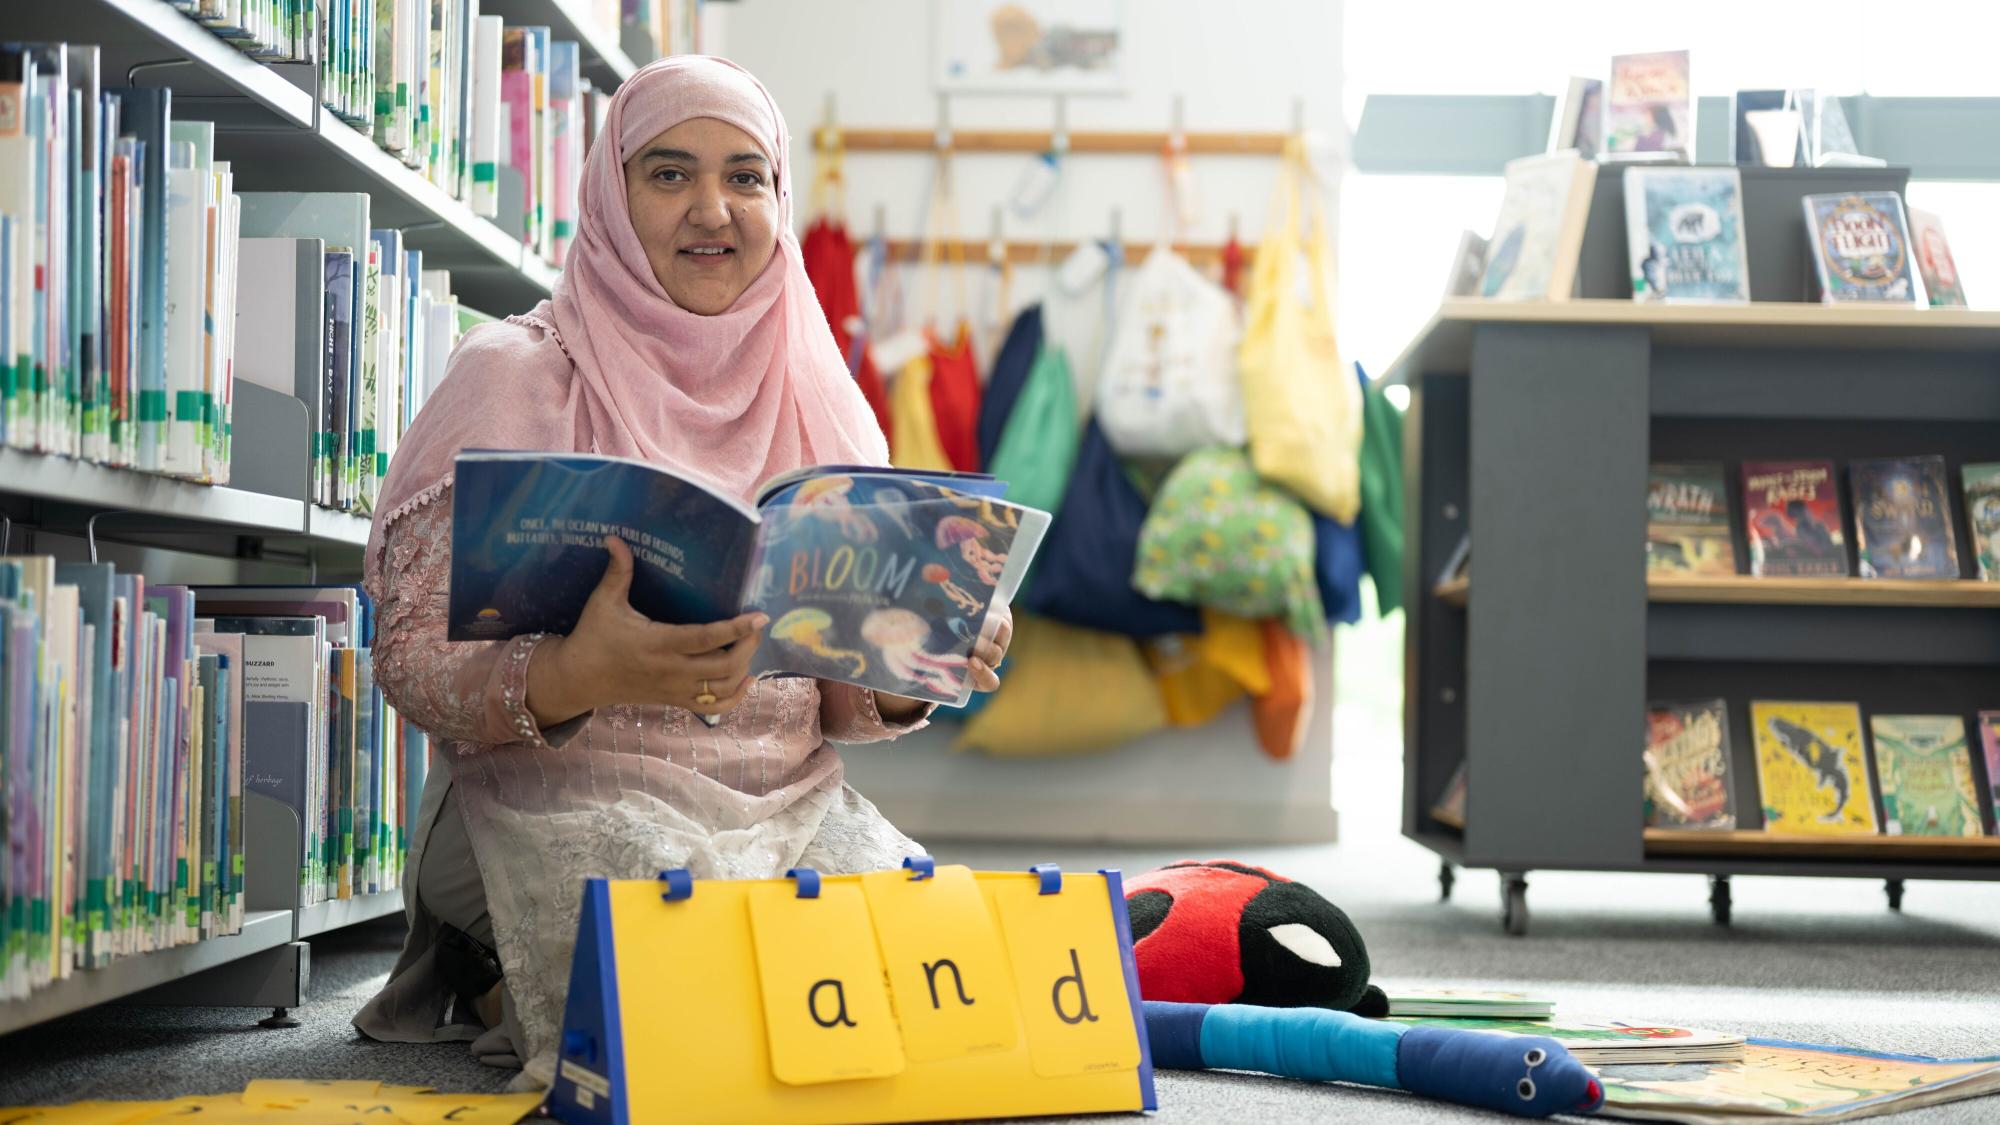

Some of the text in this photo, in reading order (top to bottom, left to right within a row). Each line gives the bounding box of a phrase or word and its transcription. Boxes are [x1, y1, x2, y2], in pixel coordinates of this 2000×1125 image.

[562, 534, 595, 548] THINGS
[568, 519, 599, 533] OCEAN
[600, 522, 620, 537] WAS
[621, 526, 640, 542] FULL
[789, 545, 917, 599] BLOOM
